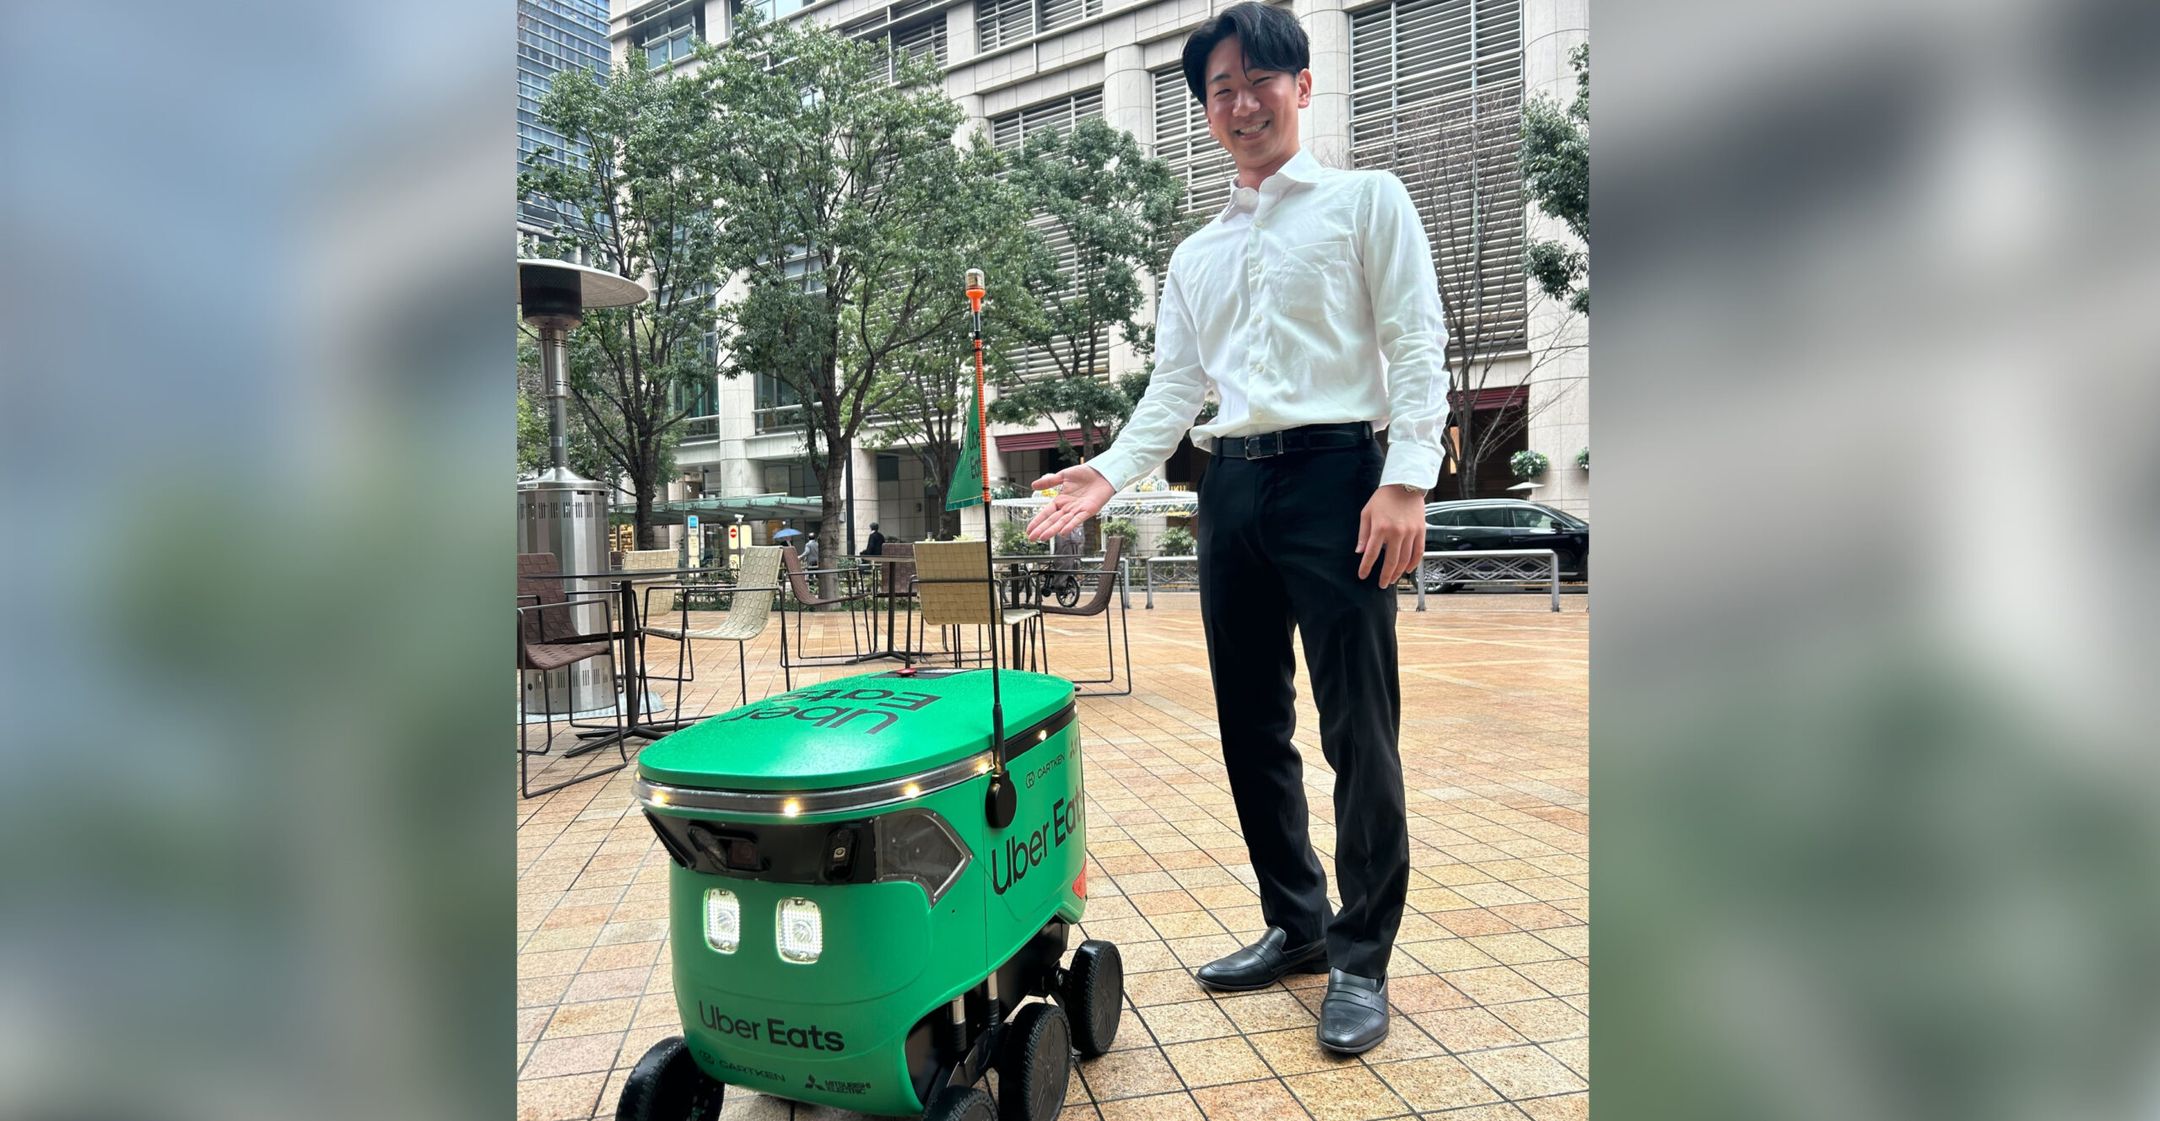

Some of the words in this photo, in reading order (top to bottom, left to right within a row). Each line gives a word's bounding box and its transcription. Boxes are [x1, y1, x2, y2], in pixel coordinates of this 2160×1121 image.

[772, 689, 943, 711] Eats
[719, 706, 899, 735] Uber
[1038, 754, 1066, 778] CARTKEN
[992, 836, 1049, 895] Uber
[699, 1000, 760, 1041] Uber
[767, 1018, 845, 1052] Eats
[719, 1059, 786, 1083] CARTKEN
